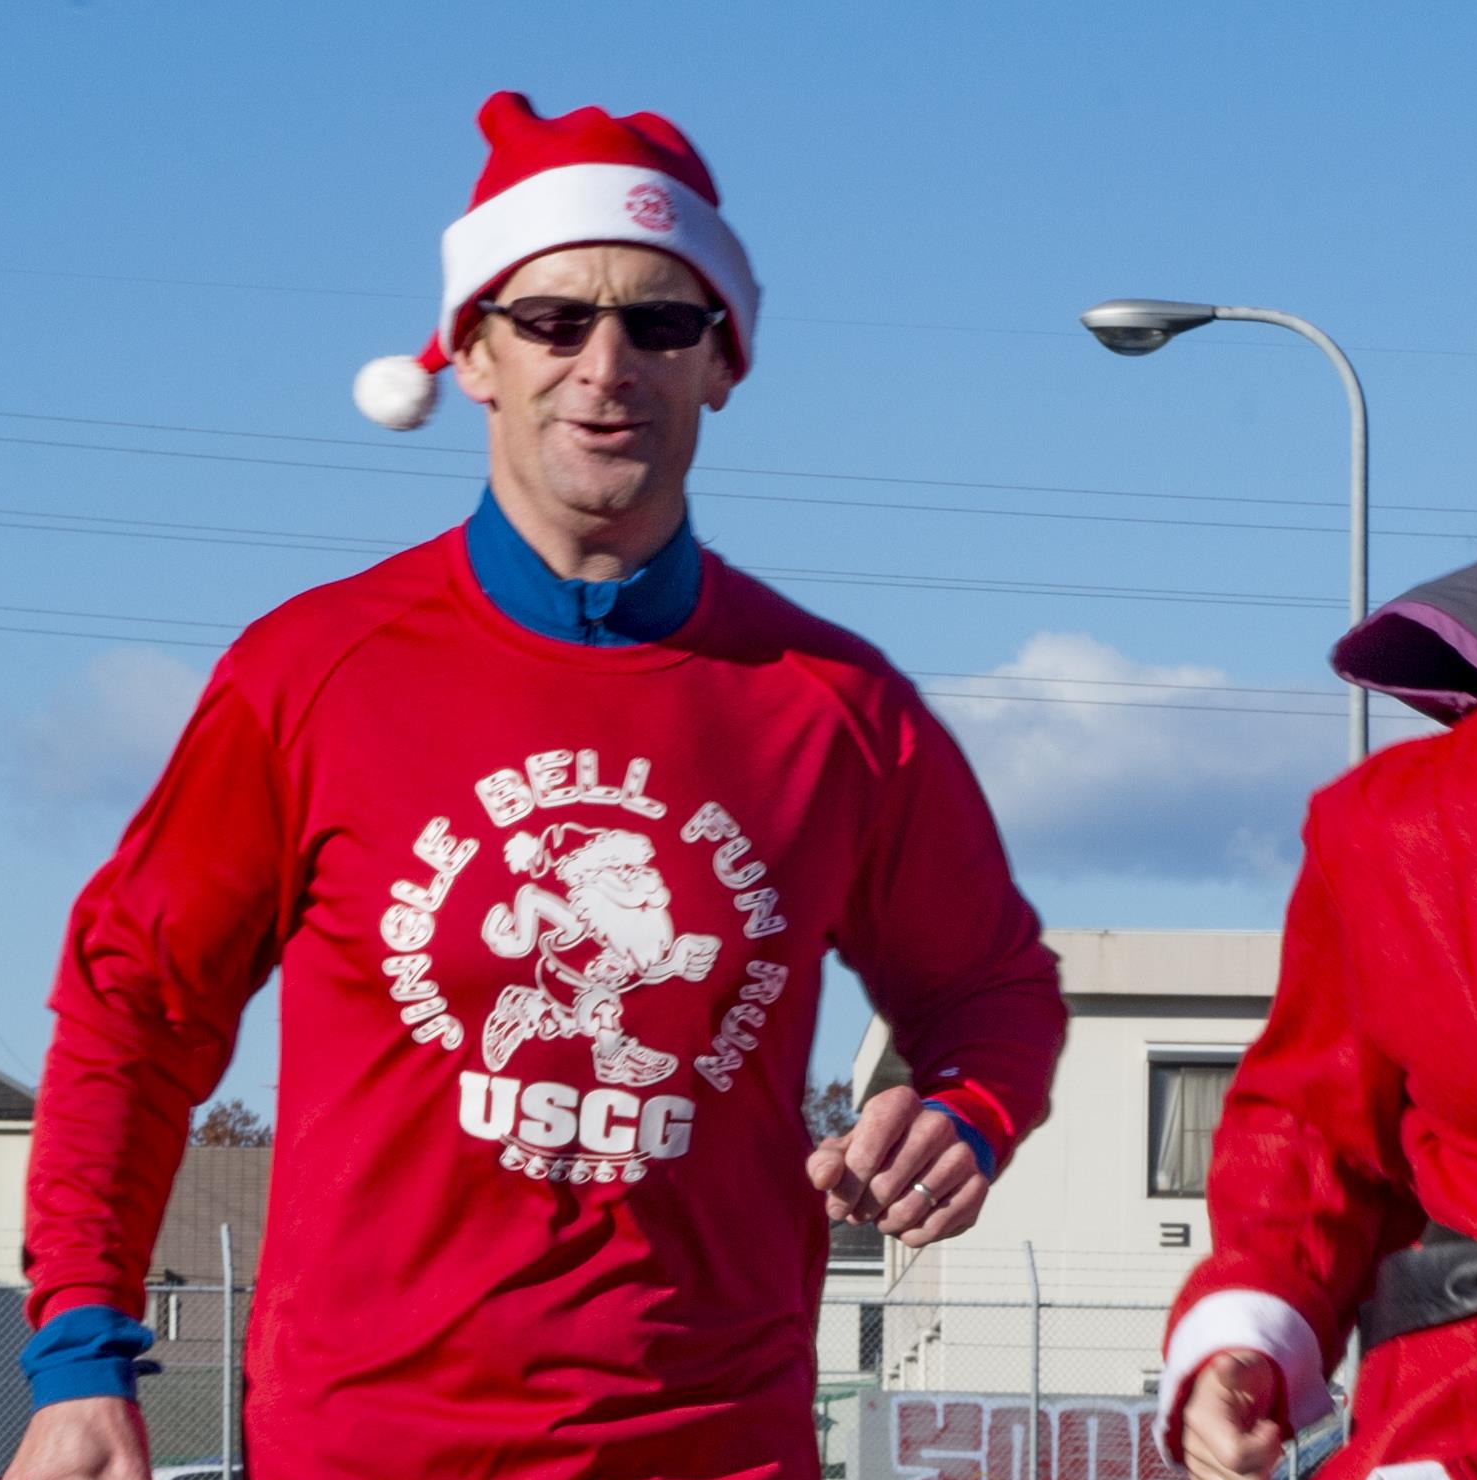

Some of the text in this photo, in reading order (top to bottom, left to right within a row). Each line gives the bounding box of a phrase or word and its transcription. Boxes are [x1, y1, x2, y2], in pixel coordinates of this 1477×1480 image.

[380, 749, 790, 1092] JINGLE BELL FUN RUN
[458, 1070, 696, 1160] USCG
